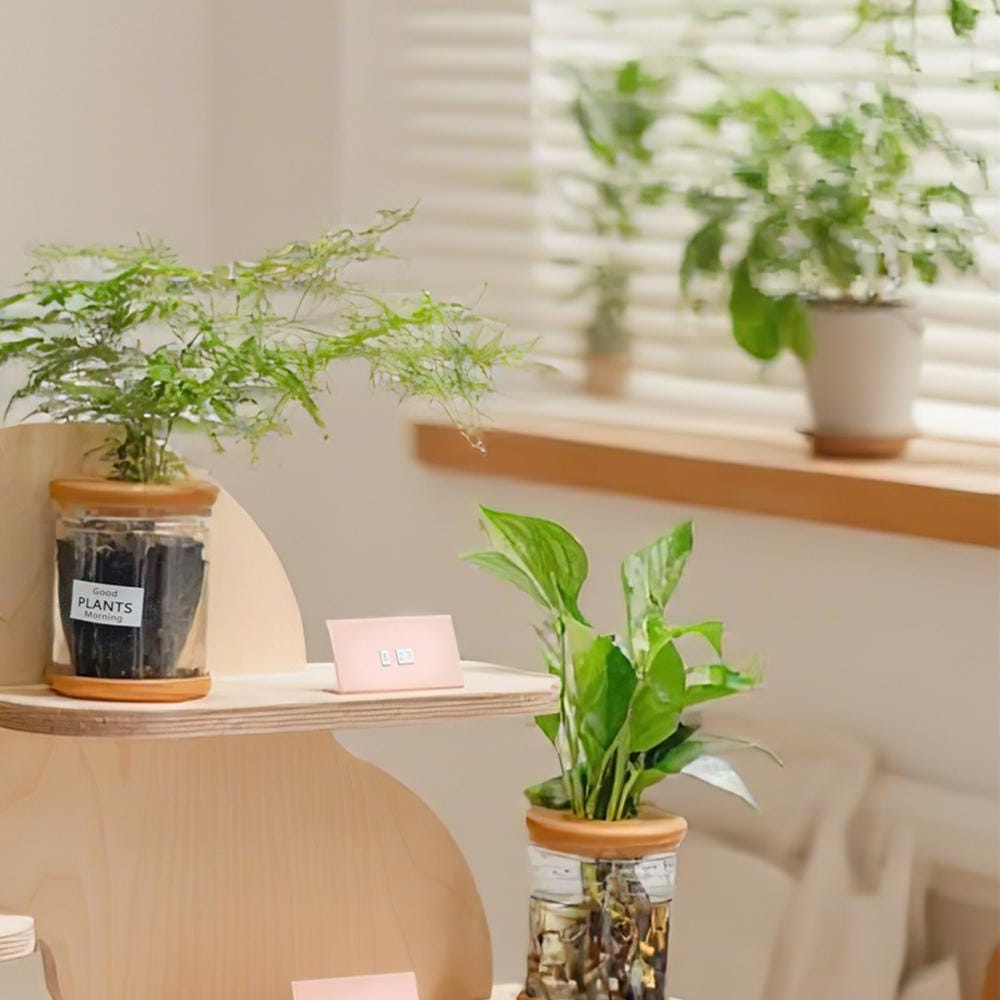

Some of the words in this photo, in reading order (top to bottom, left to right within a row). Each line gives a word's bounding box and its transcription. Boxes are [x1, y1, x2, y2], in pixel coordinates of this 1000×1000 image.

[92, 587, 118, 598] Good
[78, 596, 133, 614] PLANTS
[84, 610, 123, 623] Morning
